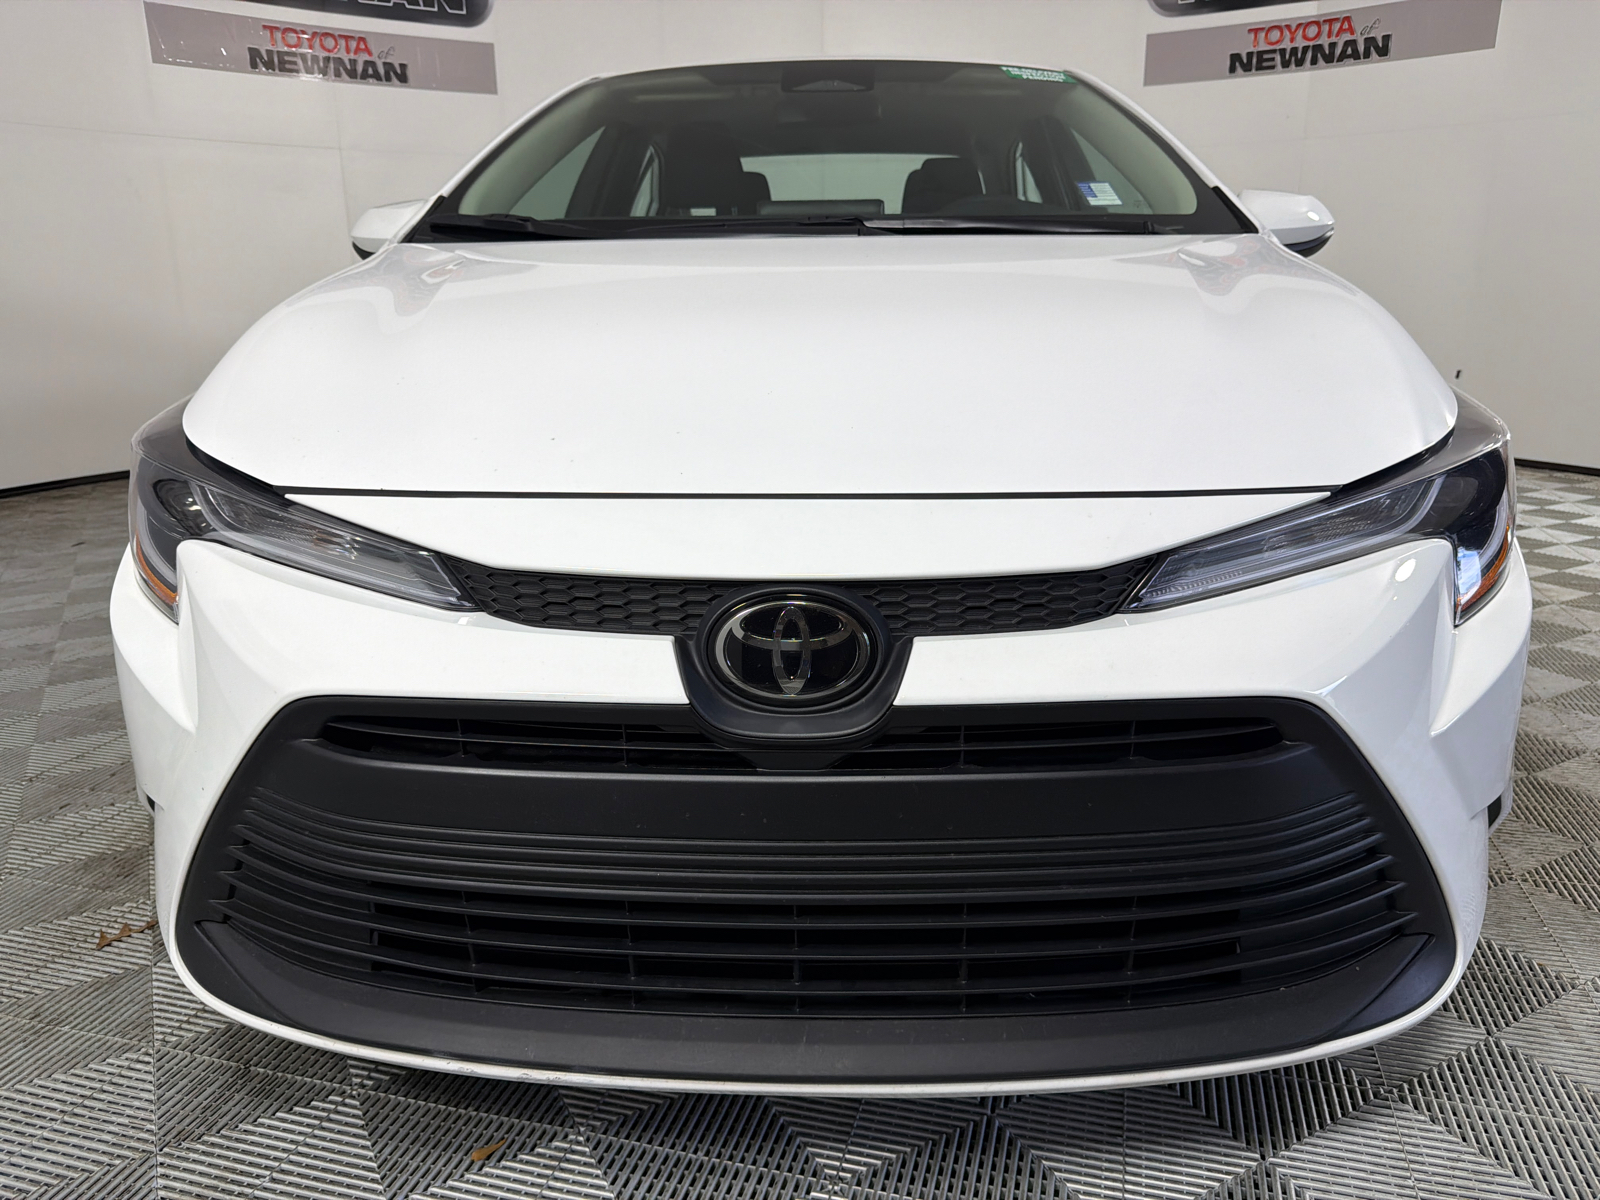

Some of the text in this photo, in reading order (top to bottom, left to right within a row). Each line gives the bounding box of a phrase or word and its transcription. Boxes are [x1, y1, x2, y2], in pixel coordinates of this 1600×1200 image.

[262, 24, 395, 60] TOYOTA of
[1248, 15, 1380, 48] TOYOTA of
[247, 46, 408, 83] NEWNAN
[1228, 34, 1392, 74] NEWNAN
